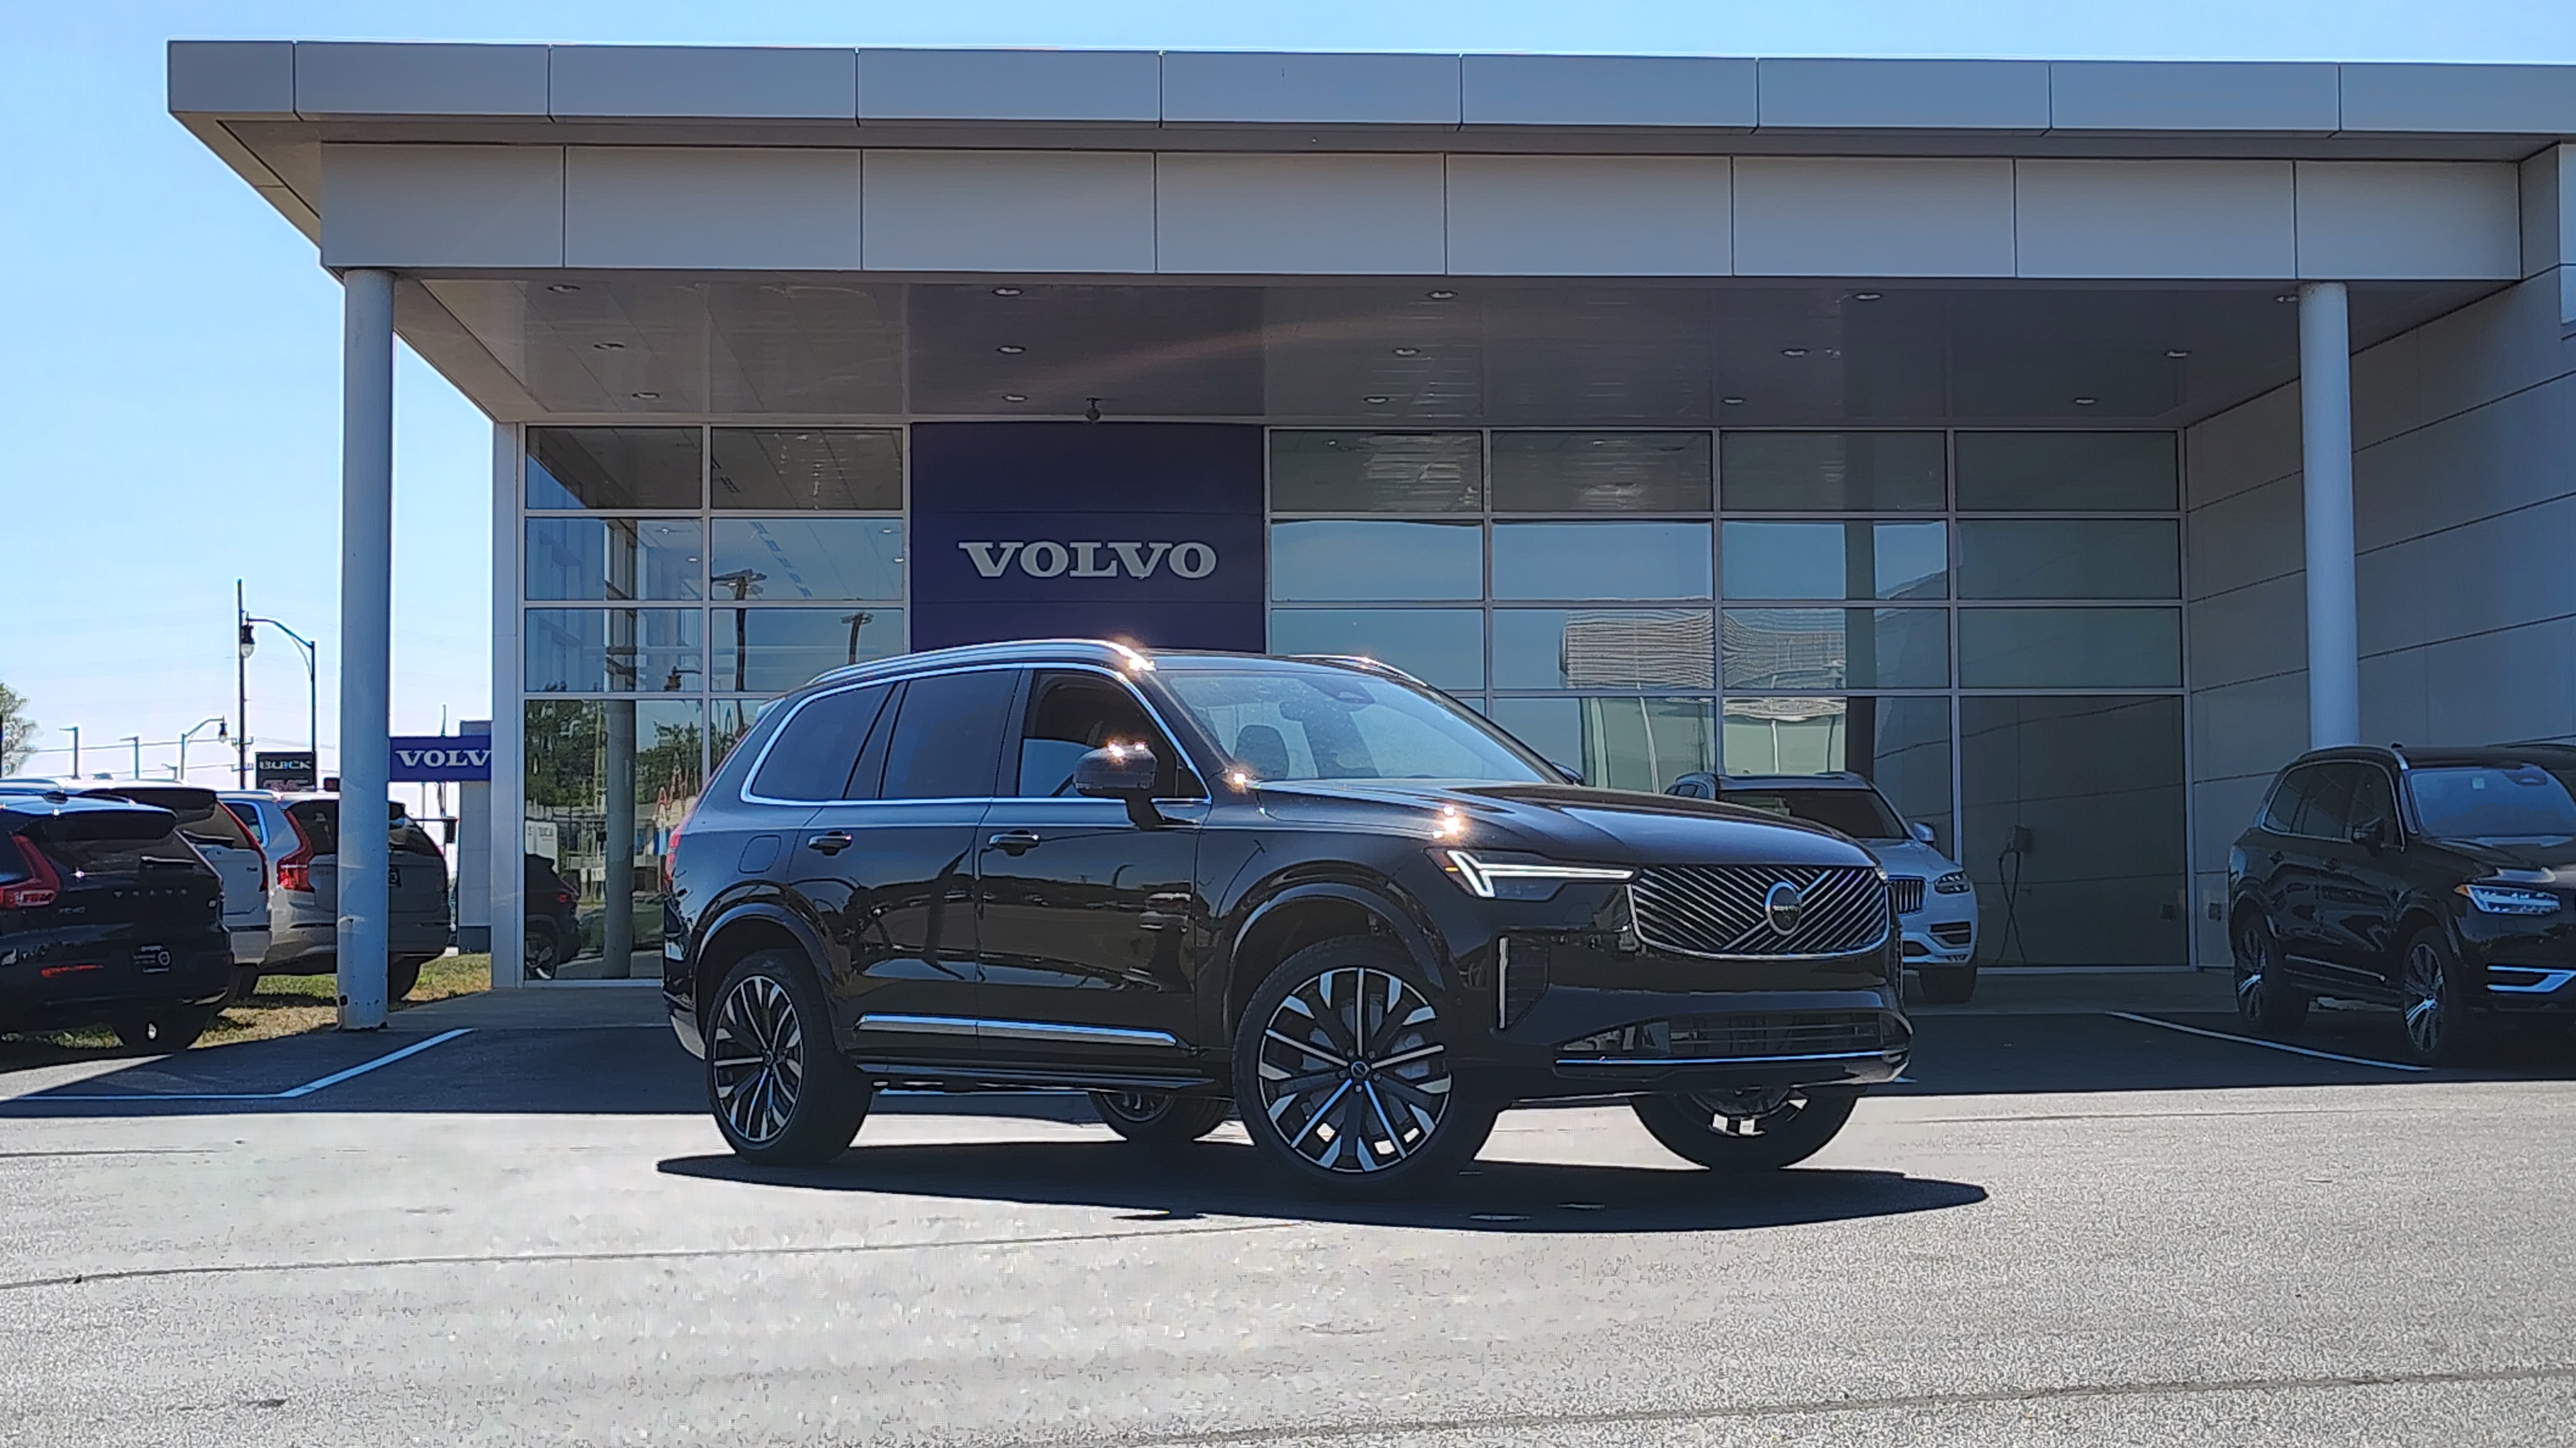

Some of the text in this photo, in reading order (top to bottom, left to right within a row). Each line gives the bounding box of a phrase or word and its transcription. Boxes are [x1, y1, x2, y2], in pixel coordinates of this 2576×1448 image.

[958, 540, 1217, 578] VOLVO
[259, 760, 312, 769] BUICK
[395, 749, 492, 768] VOLV
